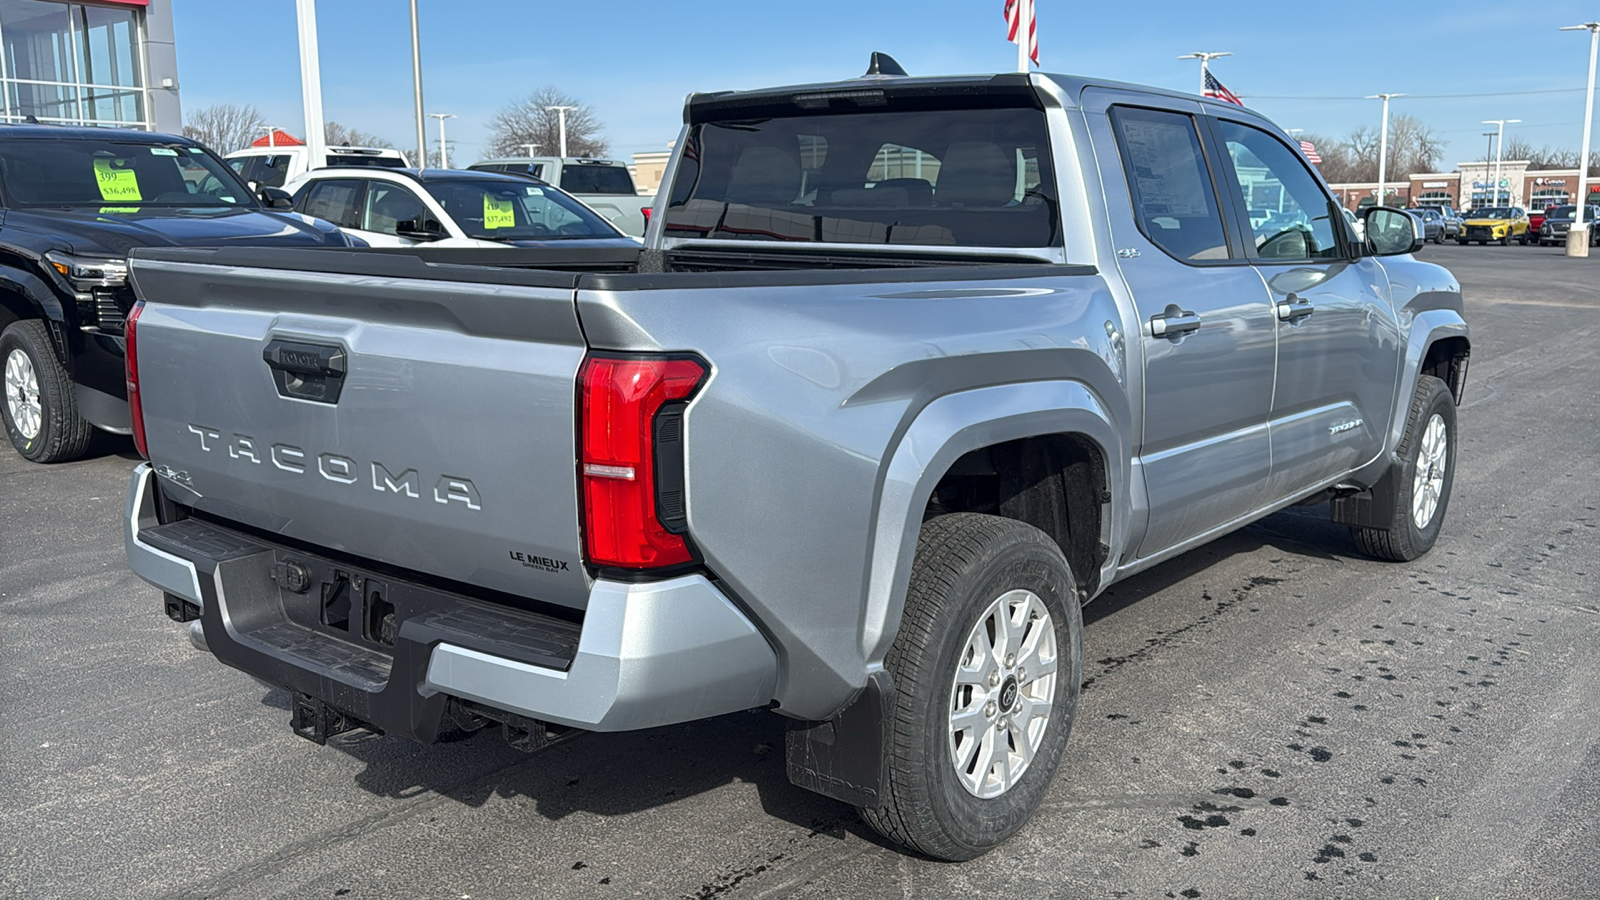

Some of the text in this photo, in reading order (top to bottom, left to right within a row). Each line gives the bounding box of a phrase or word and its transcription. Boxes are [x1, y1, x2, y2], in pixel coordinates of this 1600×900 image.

[99, 173, 117, 182] 399
[102, 187, 137, 195] $36,498
[281, 350, 319, 367] TOYOTA
[187, 423, 482, 511] TACOMA
[509, 550, 569, 571] LE MIEUX
[522, 562, 544, 571] GREEN
